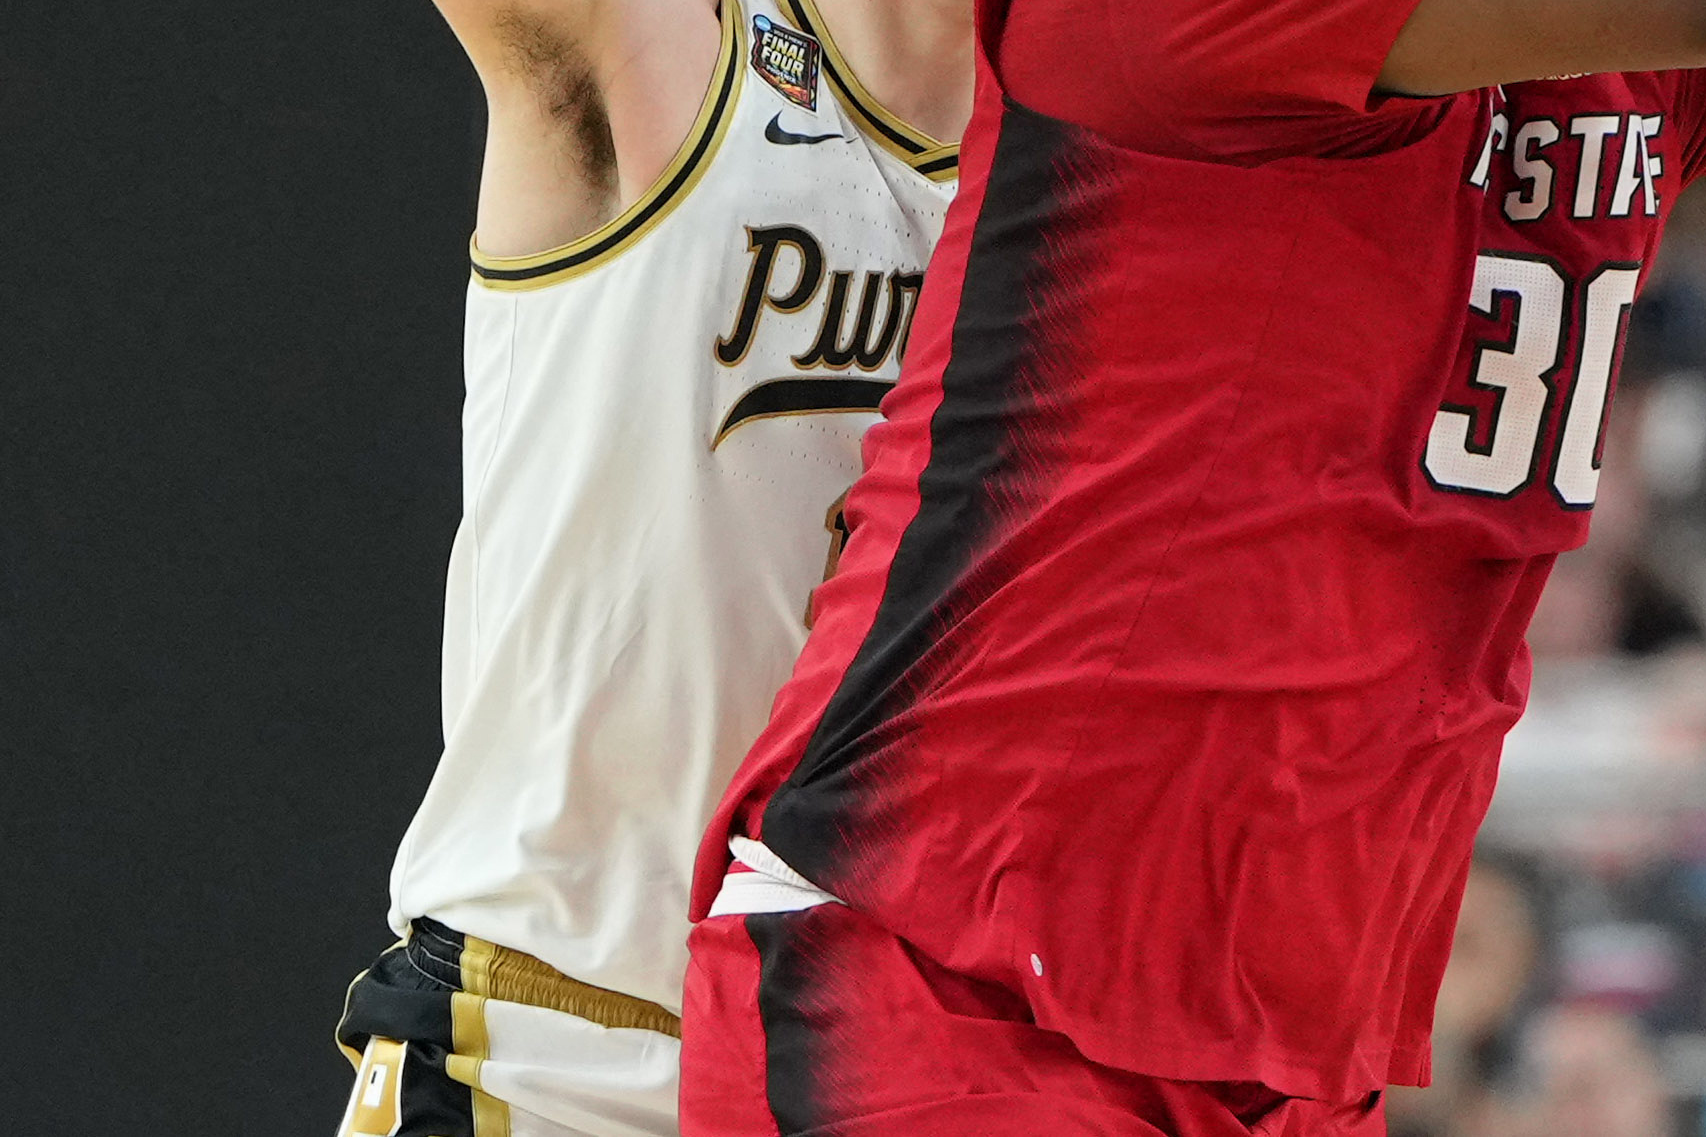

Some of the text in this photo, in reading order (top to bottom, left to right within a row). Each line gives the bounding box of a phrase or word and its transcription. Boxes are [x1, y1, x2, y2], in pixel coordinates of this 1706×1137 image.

[761, 45, 804, 78] FOUR
[762, 32, 805, 63] FINAL
[1420, 249, 1642, 512] 30
